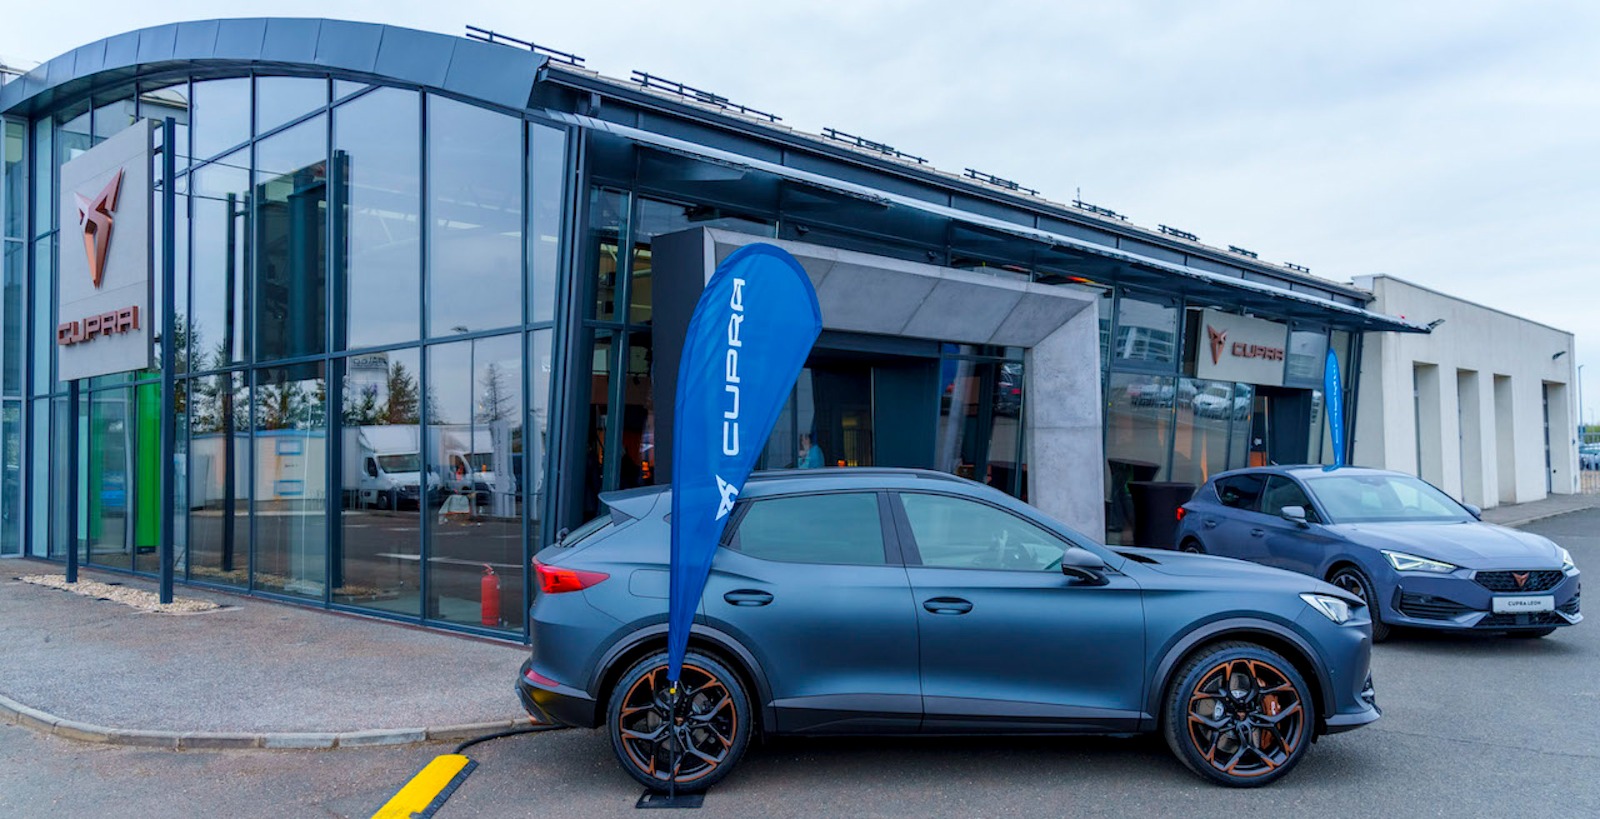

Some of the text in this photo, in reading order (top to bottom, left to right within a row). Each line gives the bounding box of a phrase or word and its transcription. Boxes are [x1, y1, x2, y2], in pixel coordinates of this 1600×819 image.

[57, 305, 139, 345] CUPRA
[722, 278, 746, 456] CUPRA
[1231, 342, 1284, 361] CUPRA
